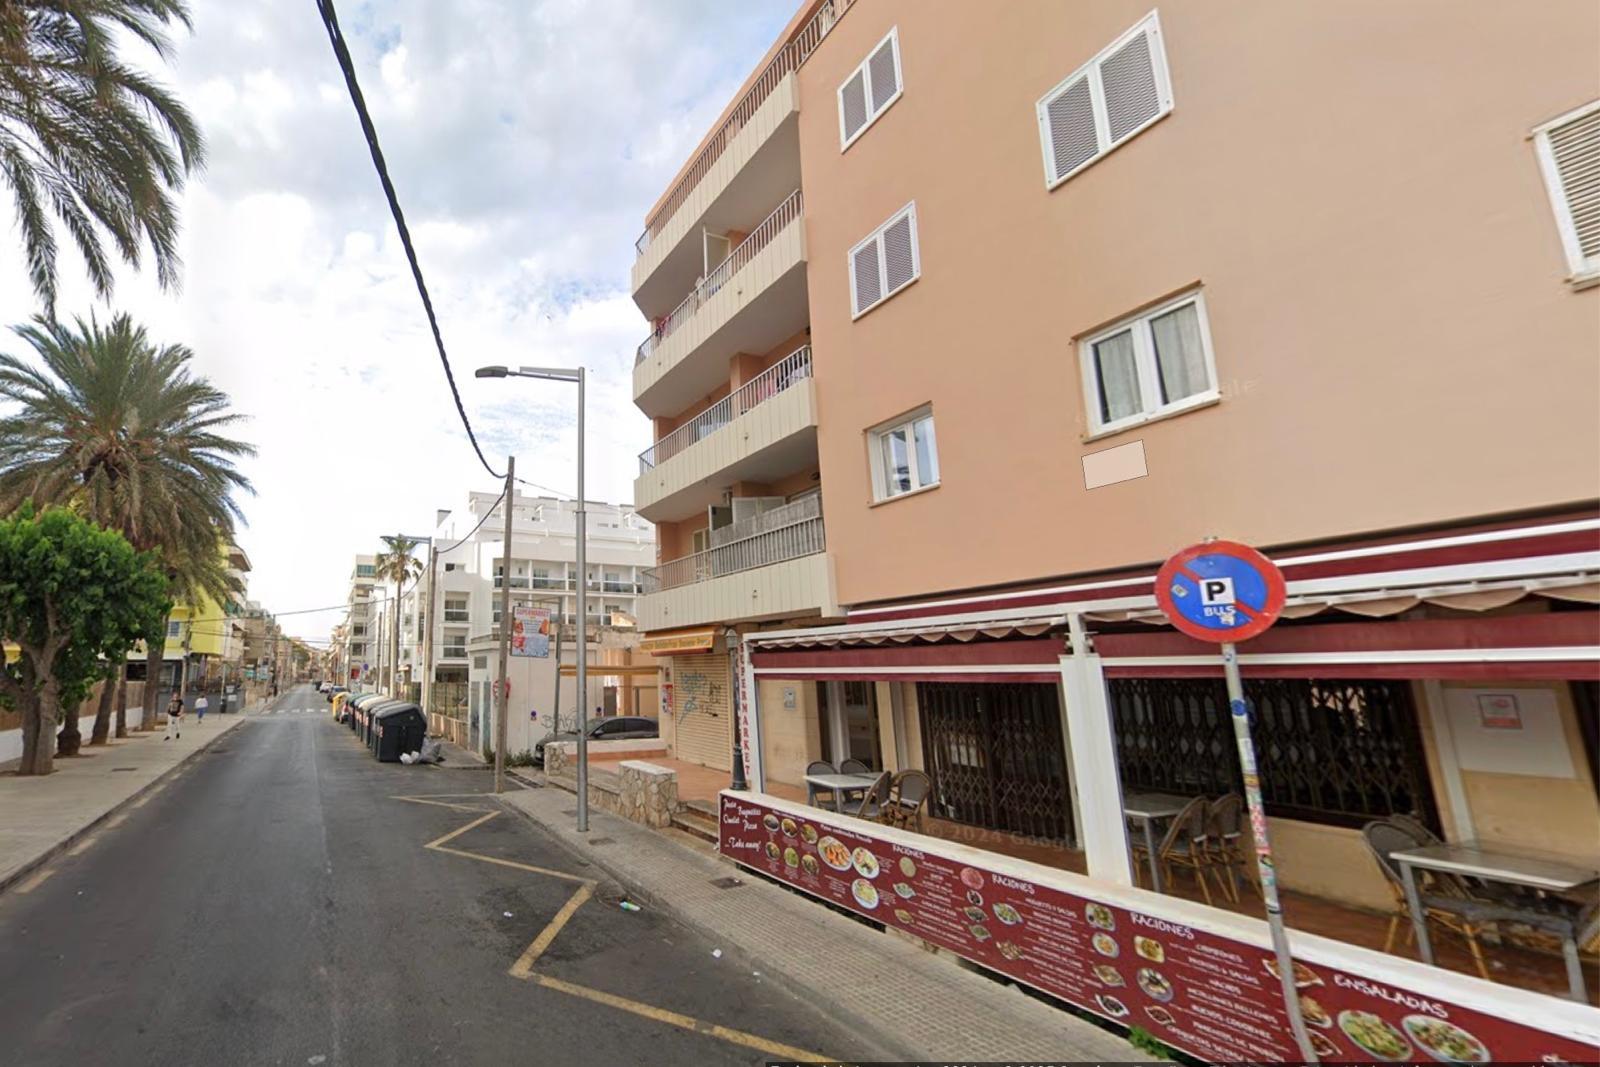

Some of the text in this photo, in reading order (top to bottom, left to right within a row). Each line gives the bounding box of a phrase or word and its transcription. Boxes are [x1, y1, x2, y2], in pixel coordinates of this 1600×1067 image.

[1206, 581, 1225, 601] P
[1204, 605, 1236, 617] BUS
[992, 874, 1035, 895] RACIONES
[1130, 912, 1195, 940] RACIONES
[1334, 974, 1449, 1018] ENSALADAS
